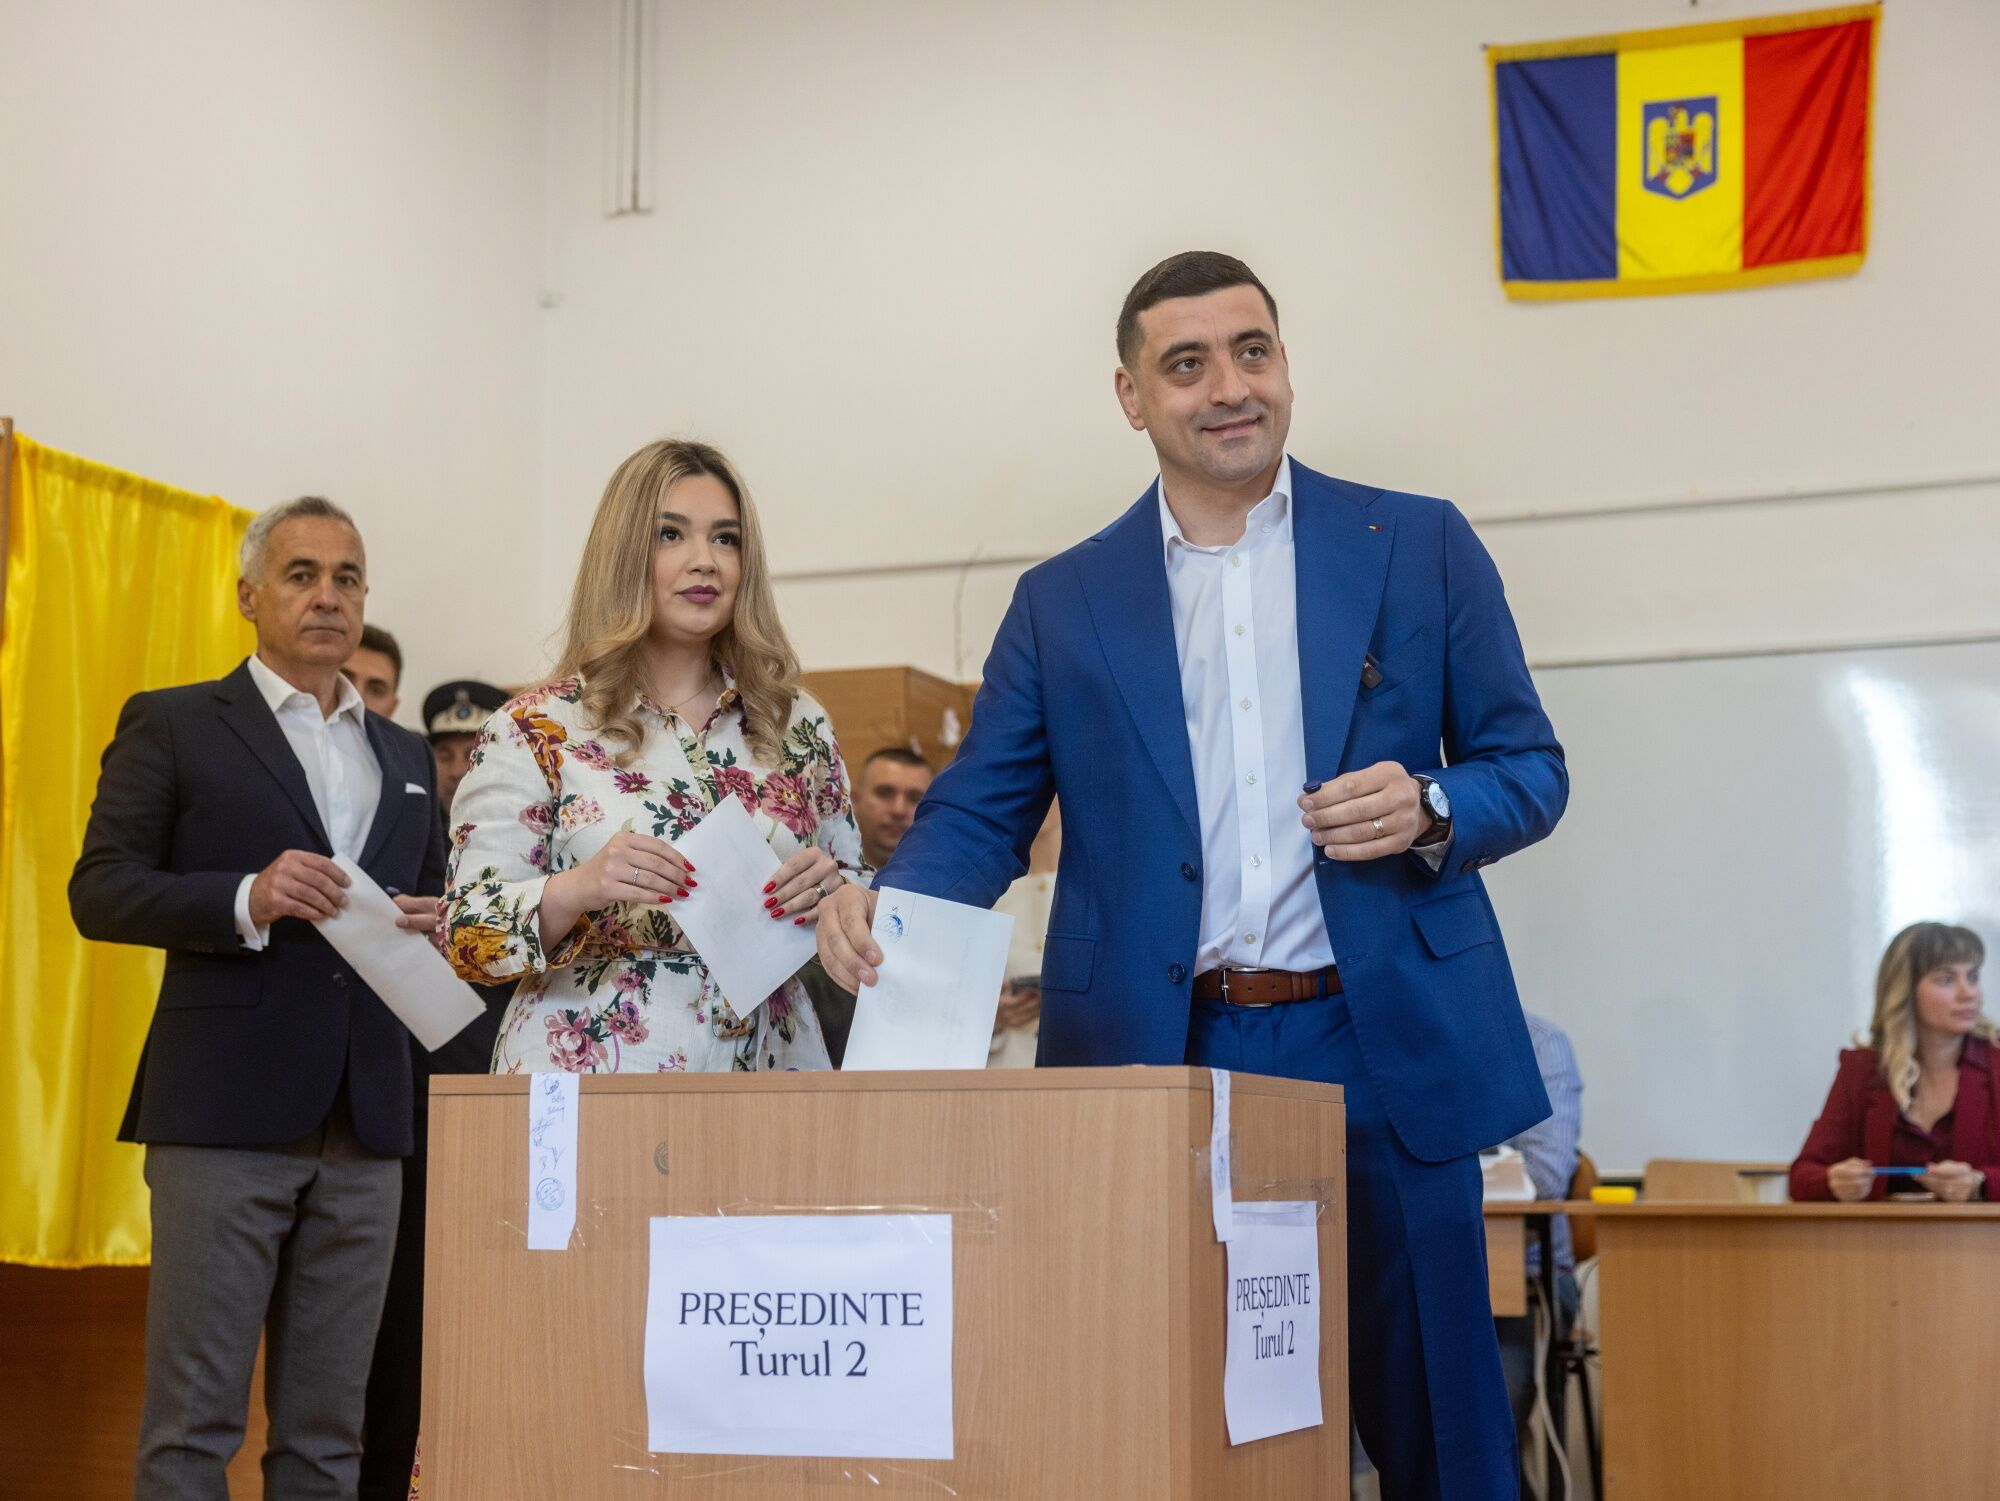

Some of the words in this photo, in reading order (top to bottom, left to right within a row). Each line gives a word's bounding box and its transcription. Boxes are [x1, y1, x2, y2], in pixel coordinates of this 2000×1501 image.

[679, 1292, 924, 1338] PREȘEDINTE
[1236, 1273, 1311, 1319] PREȘEDINTE
[729, 1339, 831, 1377] Turul
[845, 1340, 868, 1377] 2
[1252, 1320, 1284, 1361] Turul
[1286, 1320, 1295, 1356] 2
